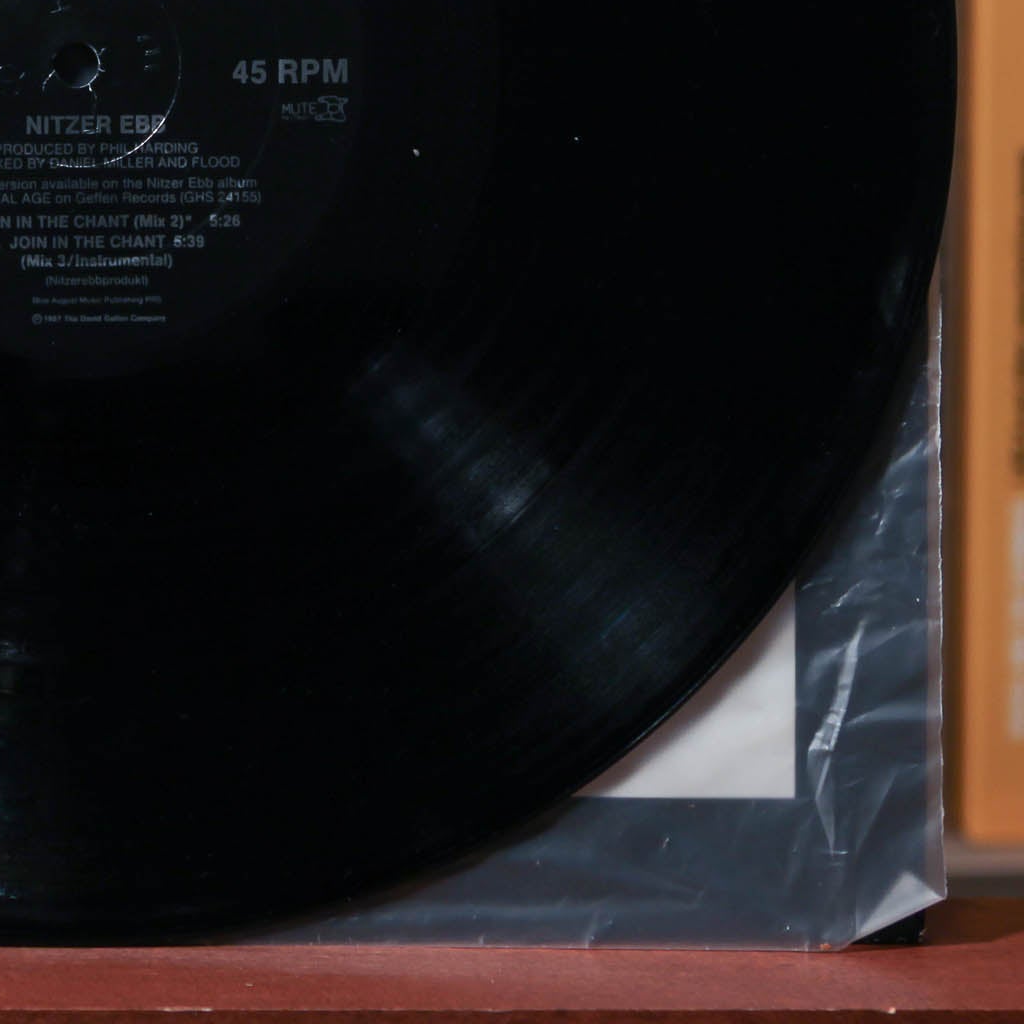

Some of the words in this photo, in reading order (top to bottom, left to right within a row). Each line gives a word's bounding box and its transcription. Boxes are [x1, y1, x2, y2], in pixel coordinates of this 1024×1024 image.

[232, 59, 267, 85] 45
[278, 58, 348, 84] RPM
[281, 102, 317, 115] MUTE
[25, 115, 112, 135] NITZER
[119, 114, 167, 134] EBB
[77, 143, 96, 155] BY
[100, 142, 128, 155] PHIL
[134, 142, 199, 154] HARDING
[27, 157, 46, 169] BY
[49, 157, 96, 169] DANIEL
[103, 156, 154, 168] MILLER
[158, 156, 188, 168] AND
[191, 156, 240, 168] FLOOD
[41, 177, 99, 190] available
[102, 179, 119, 189] on
[123, 177, 144, 189] the
[147, 177, 184, 189] Nitzer
[188, 176, 214, 189] Ebb
[217, 176, 257, 189] album
[21, 191, 52, 204] AGE
[55, 193, 72, 204] on
[76, 191, 118, 205] Geffen
[122, 191, 177, 204] Records
[180, 190, 215, 206] (GHS
[217, 190, 262, 206] 24155)
[16, 215, 33, 229] IN
[37, 215, 69, 229] THE
[73, 214, 130, 228] CHANT
[133, 214, 166, 230] (Mix
[209, 214, 241, 227] 5:26
[9, 235, 48, 249] JOIN
[52, 235, 69, 249] IN
[74, 235, 105, 248] THE
[110, 234, 167, 248] CHANT
[173, 234, 205, 248] 5:39
[20, 254, 53, 270] (Mix
